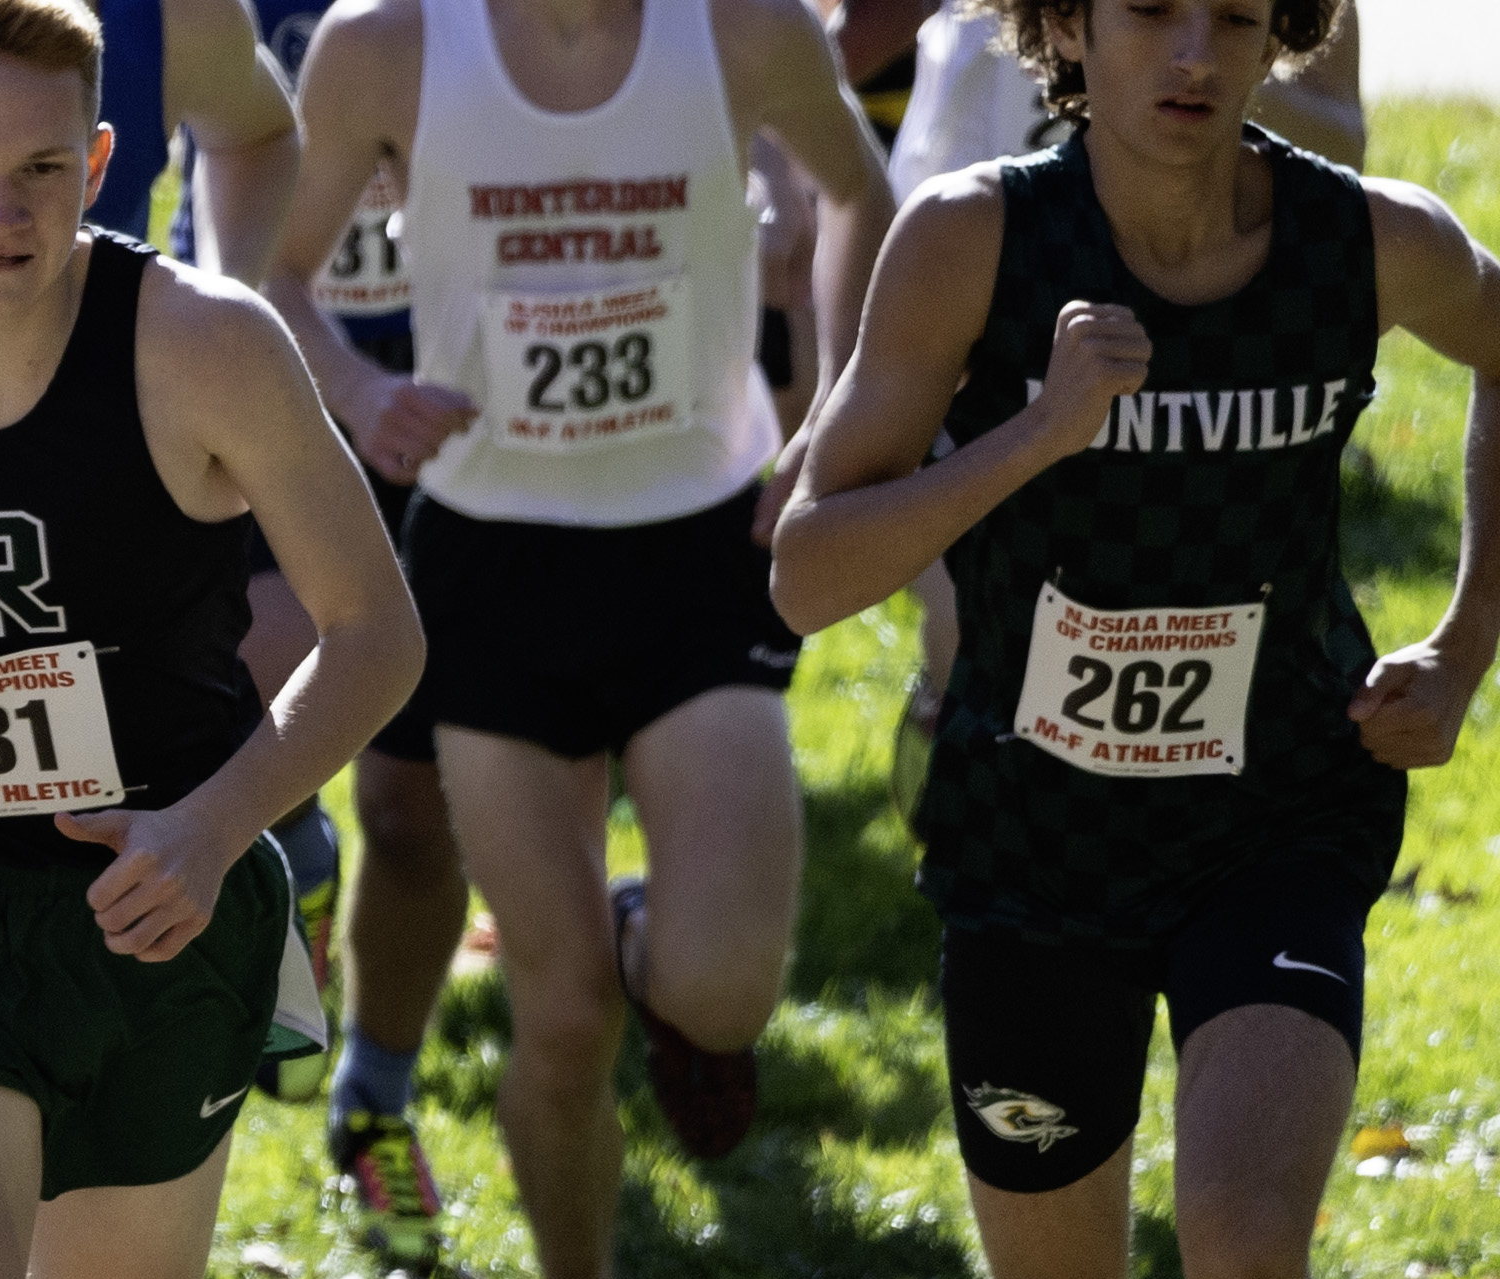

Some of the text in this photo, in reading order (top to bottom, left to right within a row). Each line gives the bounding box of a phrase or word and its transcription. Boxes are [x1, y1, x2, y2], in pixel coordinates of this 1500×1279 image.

[469, 175, 689, 219] HUNTERDON
[496, 225, 663, 266] CENTRAL
[523, 331, 654, 414] 233
[1026, 378, 1348, 453] NTVILLE
[1055, 620, 1237, 652] OF CHAMPIONS
[1064, 604, 1233, 635] NJSIAA MEET
[1060, 654, 1213, 735] 262
[1034, 715, 1224, 764] M-F ATHLETIC
